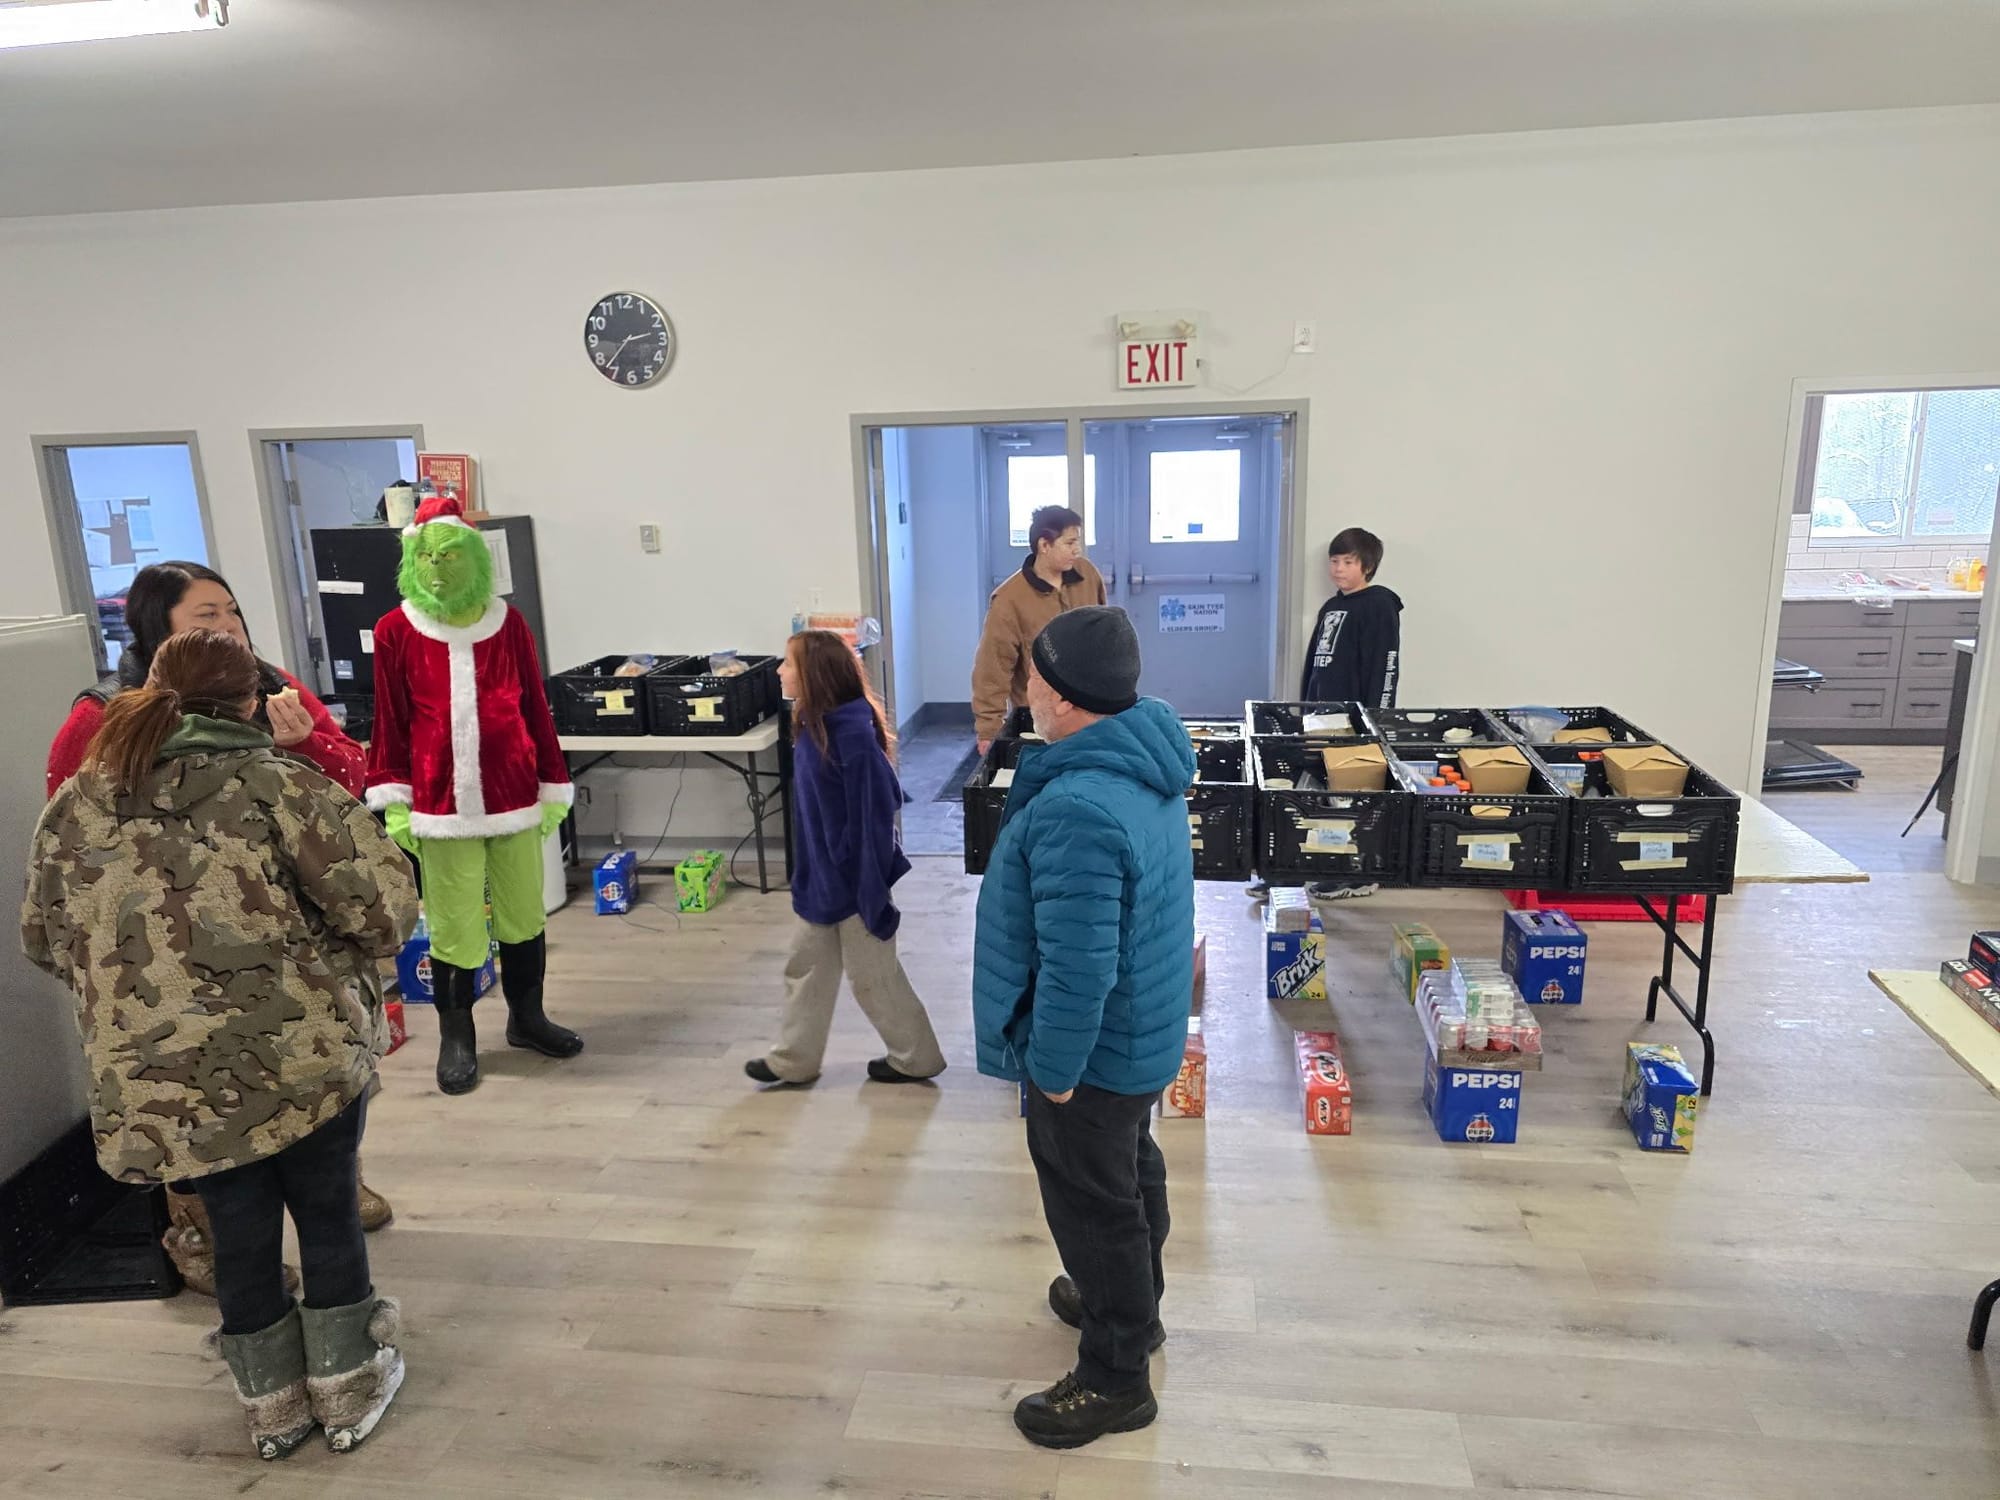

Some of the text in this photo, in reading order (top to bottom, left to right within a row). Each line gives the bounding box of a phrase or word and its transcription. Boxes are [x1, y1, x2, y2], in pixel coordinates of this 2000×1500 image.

[599, 302, 613, 316] 11
[615, 295, 633, 309] 12
[637, 300, 645, 314] 1
[589, 316, 606, 330] 10
[651, 314, 662, 328] 2
[588, 334, 599, 348] 9
[658, 332, 667, 346] 3
[595, 352, 606, 366] 8
[653, 350, 664, 364] 4
[1127, 342, 1187, 383] EXIT
[609, 366, 619, 380] 7
[626, 370, 637, 384] 6
[643, 365, 653, 379] 5
[1530, 946, 1586, 959] PEPSI
[1567, 965, 1579, 975] 24
[1453, 1073, 1520, 1089] PEPSI
[1499, 1098, 1512, 1109] 24
[1687, 1097, 1696, 1110] 12
